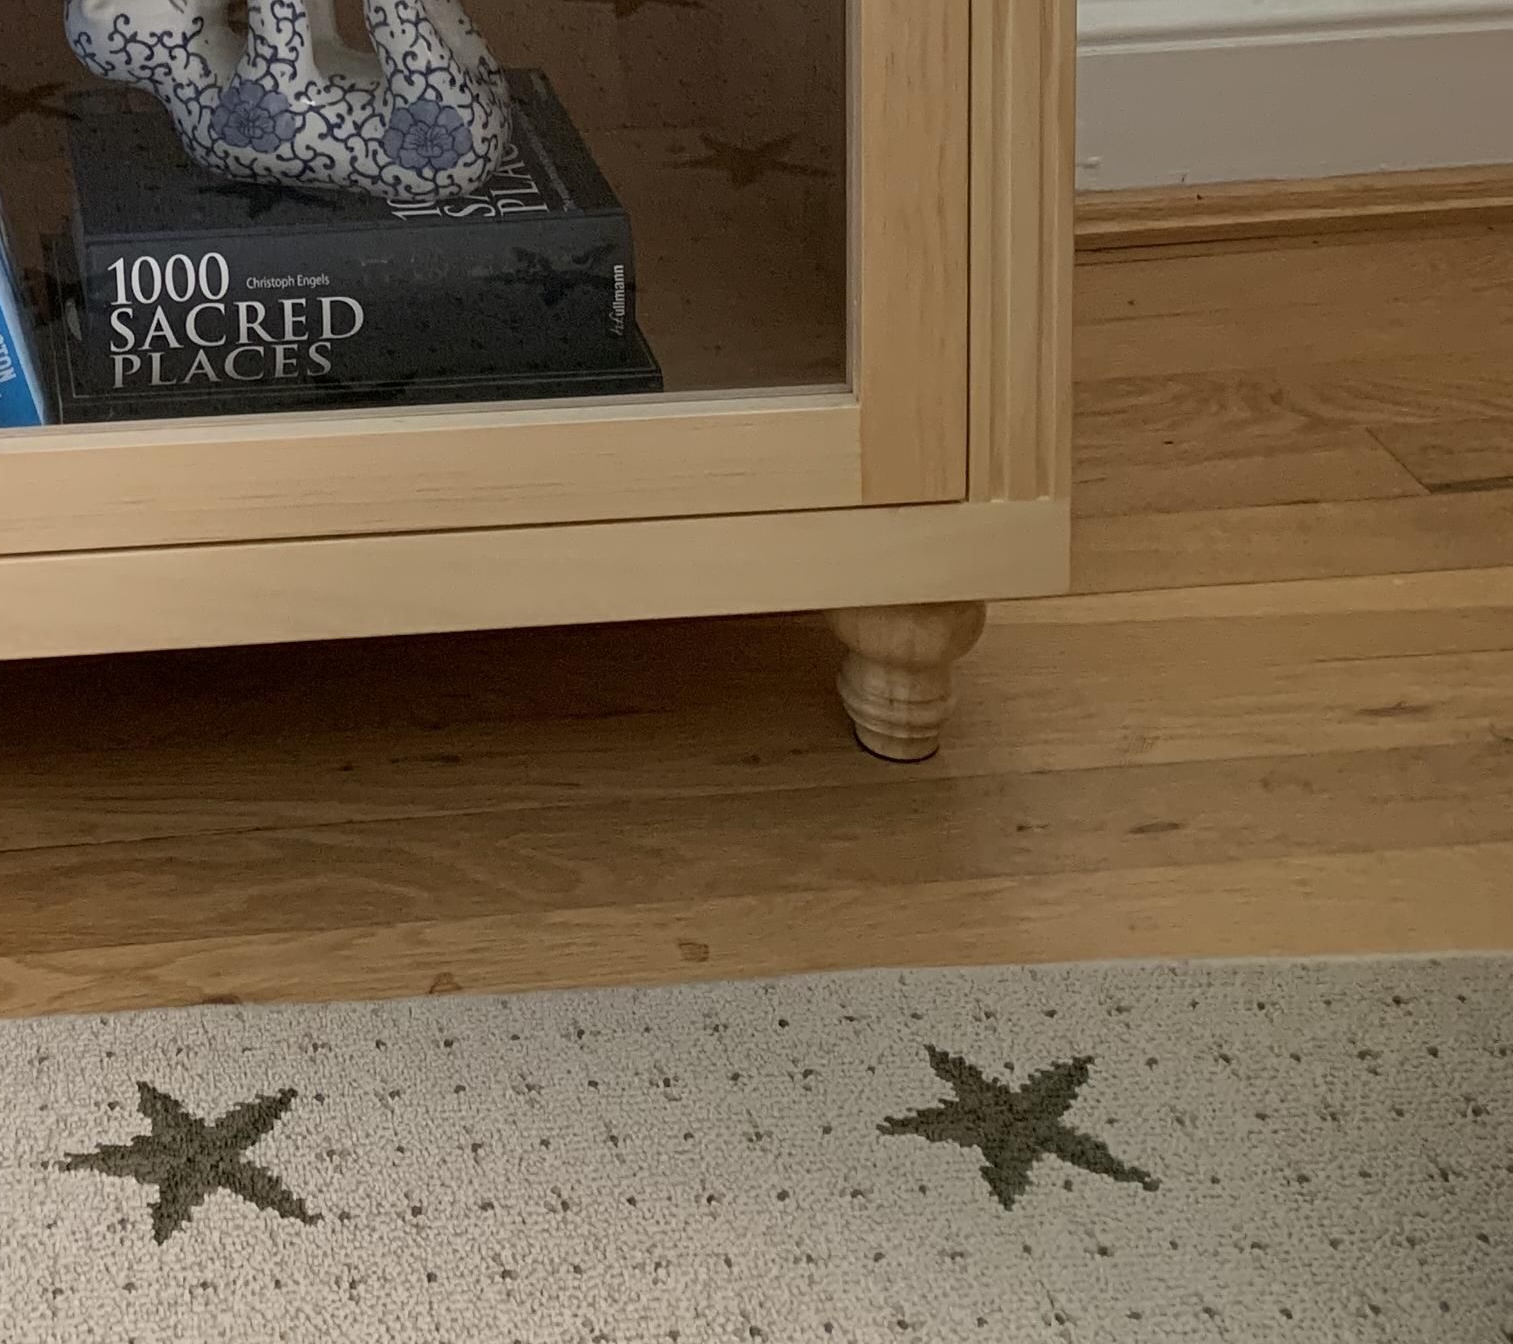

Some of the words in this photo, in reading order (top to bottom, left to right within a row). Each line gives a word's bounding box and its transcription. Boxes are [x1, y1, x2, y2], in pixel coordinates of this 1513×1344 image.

[106, 251, 230, 307] 1000
[245, 273, 296, 291] Christoph
[295, 272, 331, 289] Engels
[108, 295, 365, 354] SACRED
[109, 341, 333, 389] PLACES
